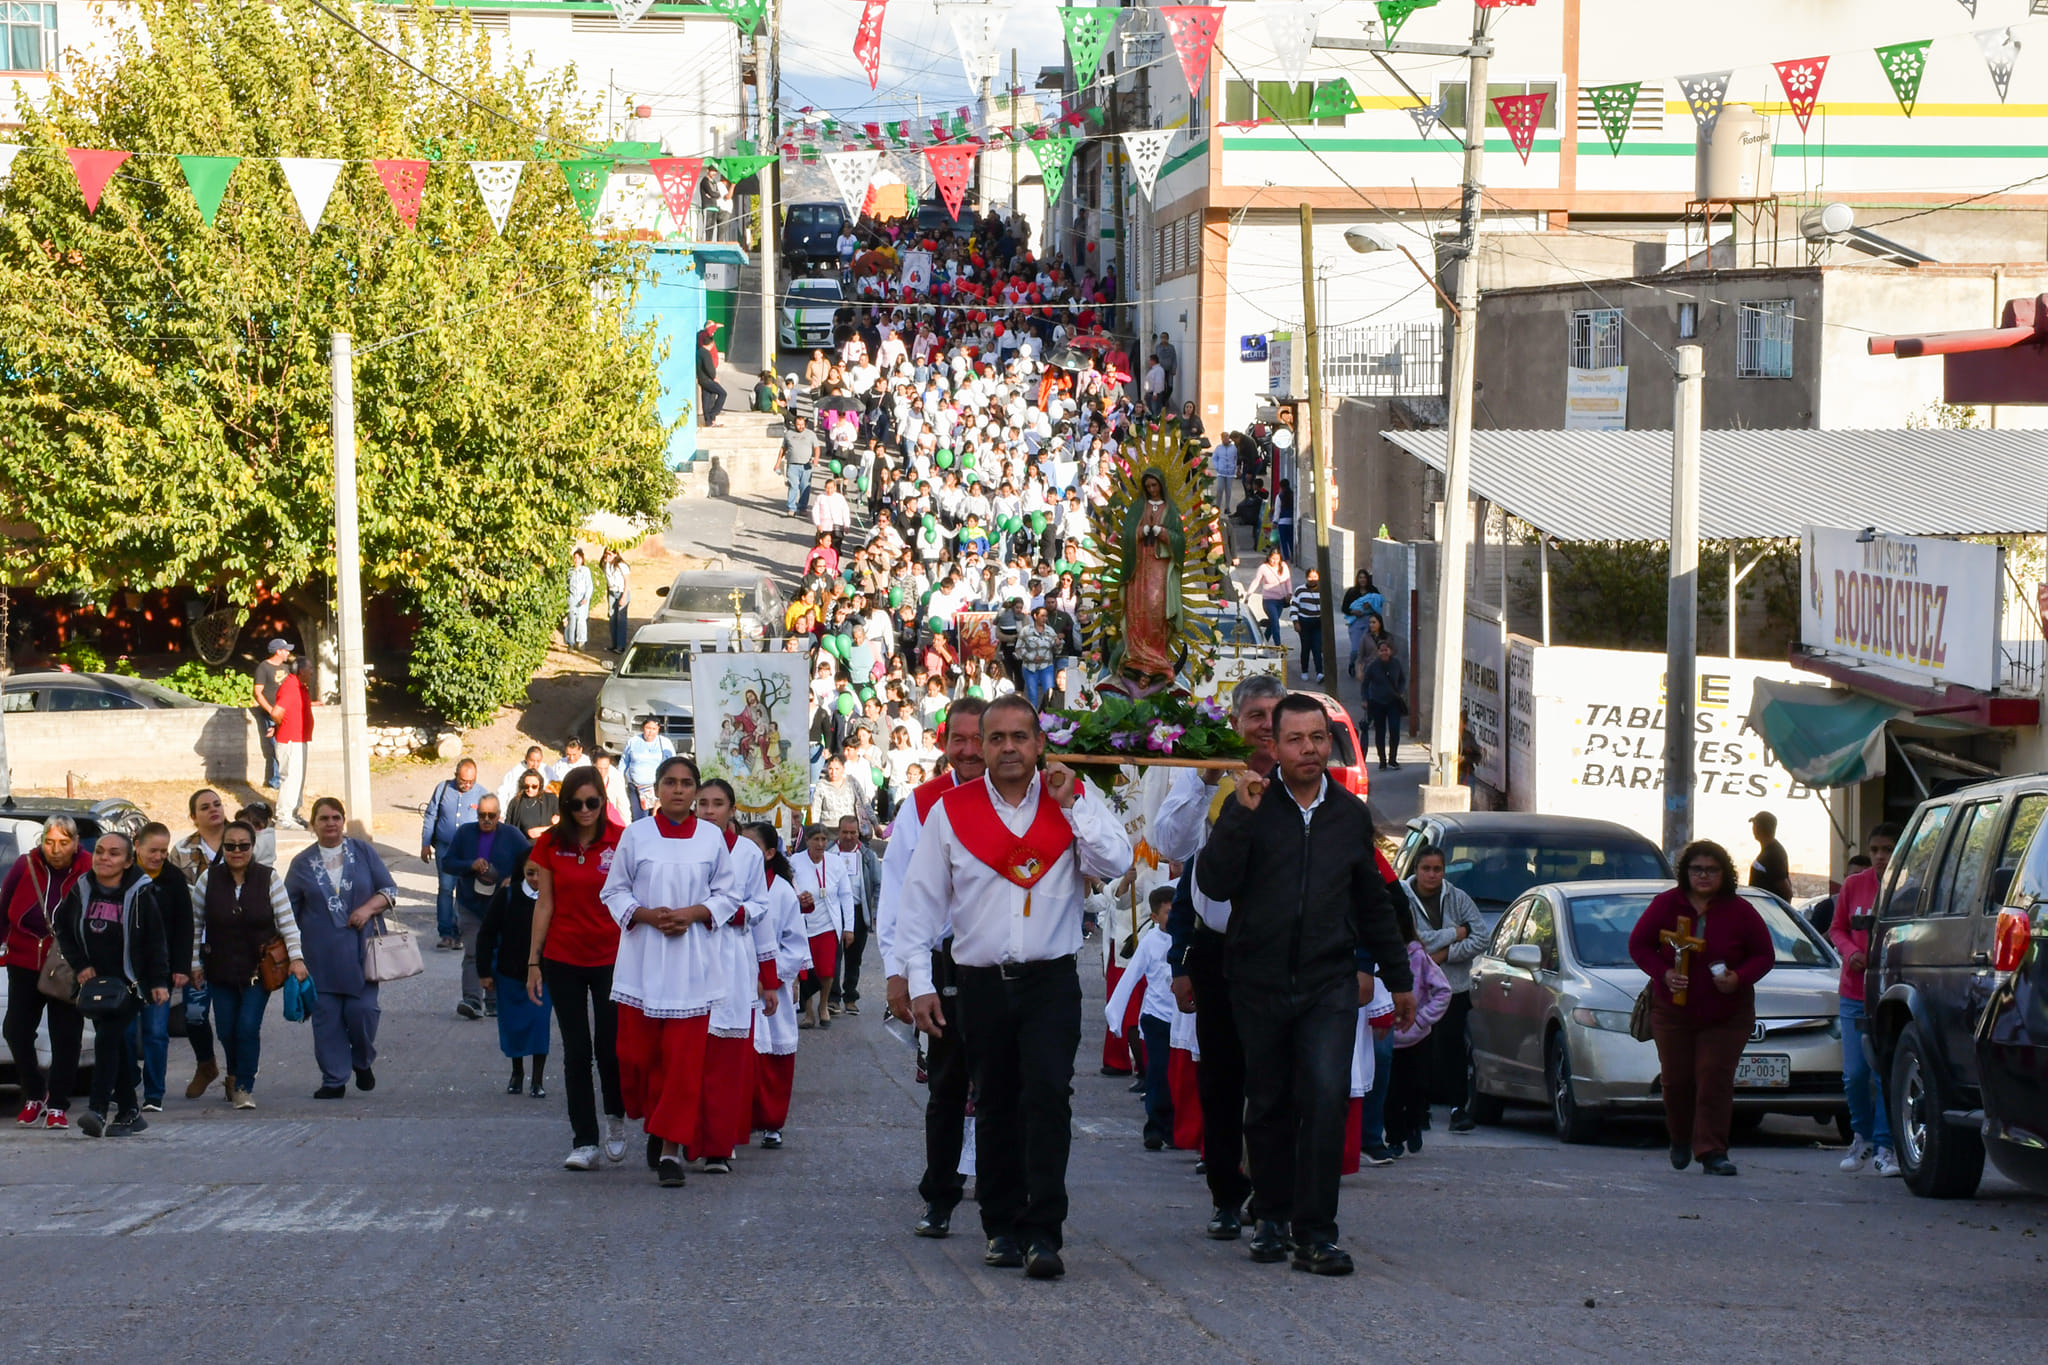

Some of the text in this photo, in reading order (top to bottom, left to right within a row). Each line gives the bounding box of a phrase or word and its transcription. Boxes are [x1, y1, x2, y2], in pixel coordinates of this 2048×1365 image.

[1886, 542, 1918, 577] SUPER
[1834, 568, 1949, 670] RODRIGUEZ
[1586, 703, 1715, 734] TABLS
[1584, 733, 1744, 766] POLES
